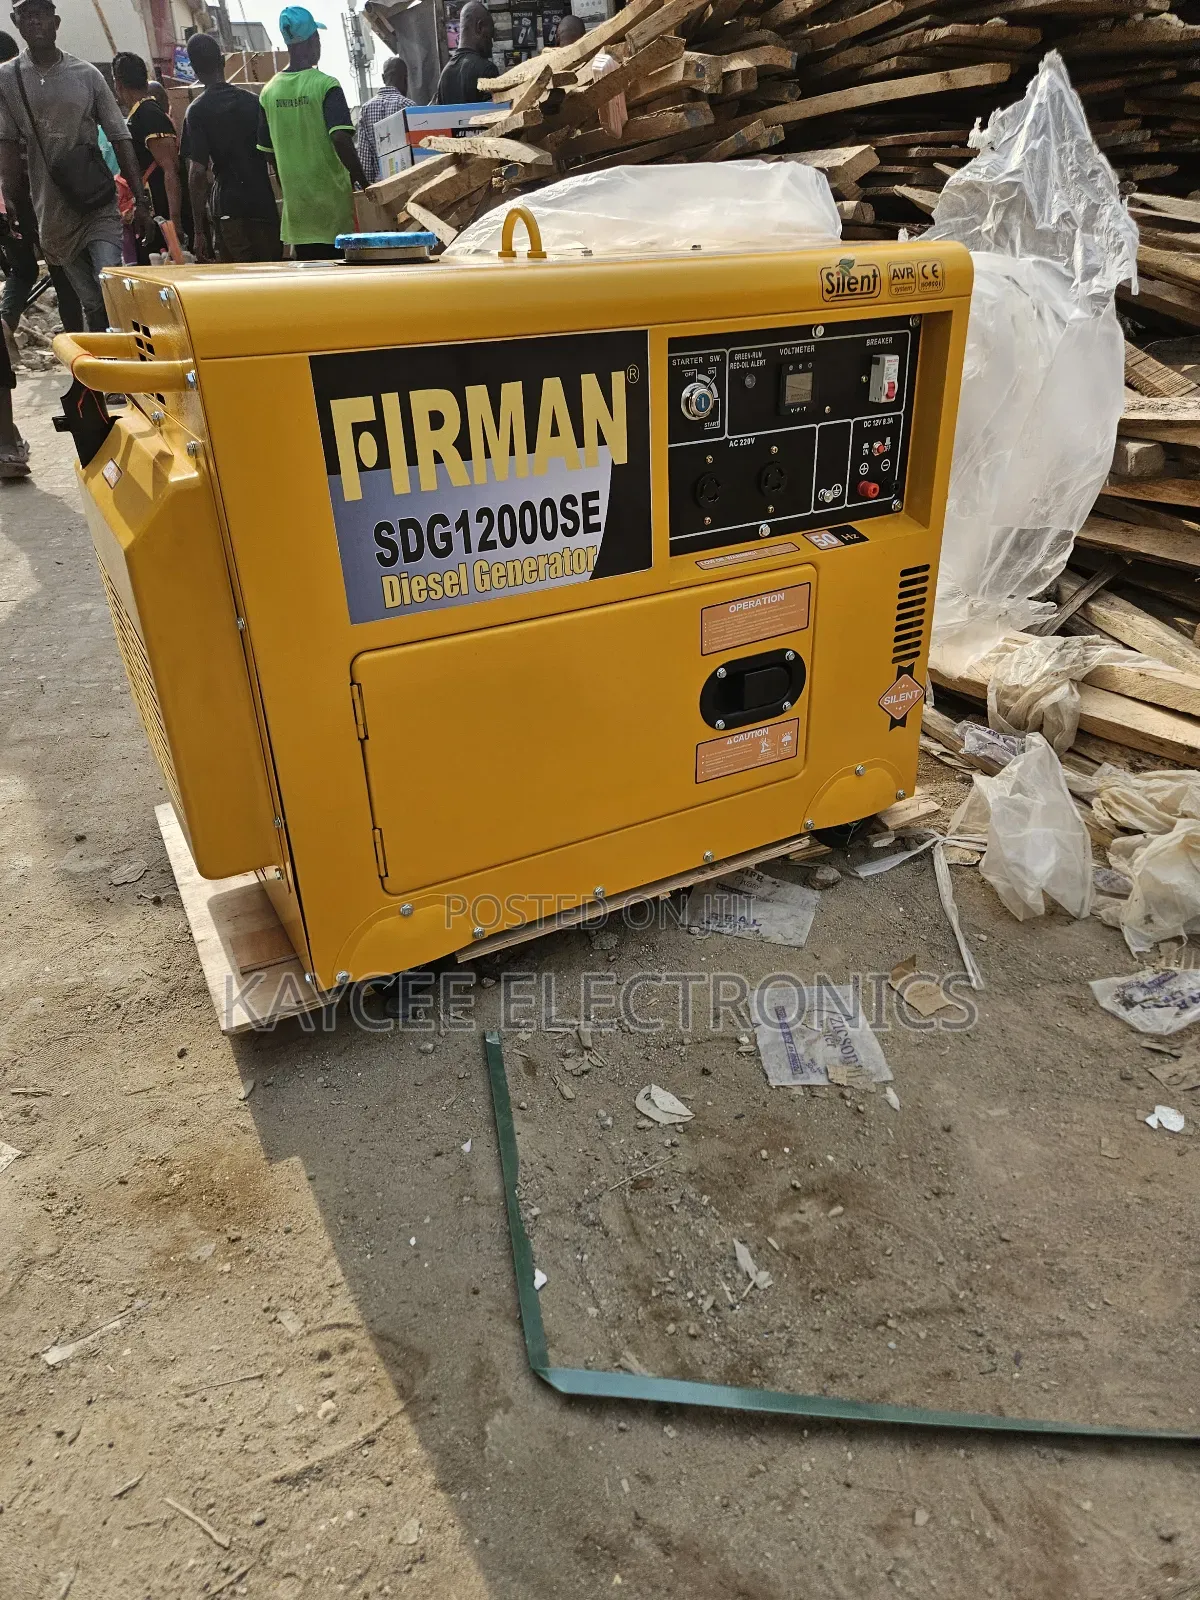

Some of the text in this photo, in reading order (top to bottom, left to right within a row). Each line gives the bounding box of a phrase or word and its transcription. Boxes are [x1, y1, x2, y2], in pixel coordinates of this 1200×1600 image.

[892, 267, 915, 281] AVR
[825, 268, 879, 295] Silent
[894, 284, 913, 293] system
[866, 337, 893, 347] BREAKER
[779, 345, 815, 356] VOLTMETER
[672, 356, 704, 366] STARTER
[750, 359, 767, 367] ALERT
[863, 420, 872, 428] DC
[329, 370, 628, 502] FIRMAN
[728, 437, 756, 448] AC 220V
[373, 490, 602, 568] SDG12000SE
[810, 533, 860, 547] 50 Hz
[381, 544, 598, 610] Diesel Generator
[728, 592, 786, 614] OPERATION
[883, 690, 921, 705] SILENT
[733, 727, 769, 744] CAUTION
